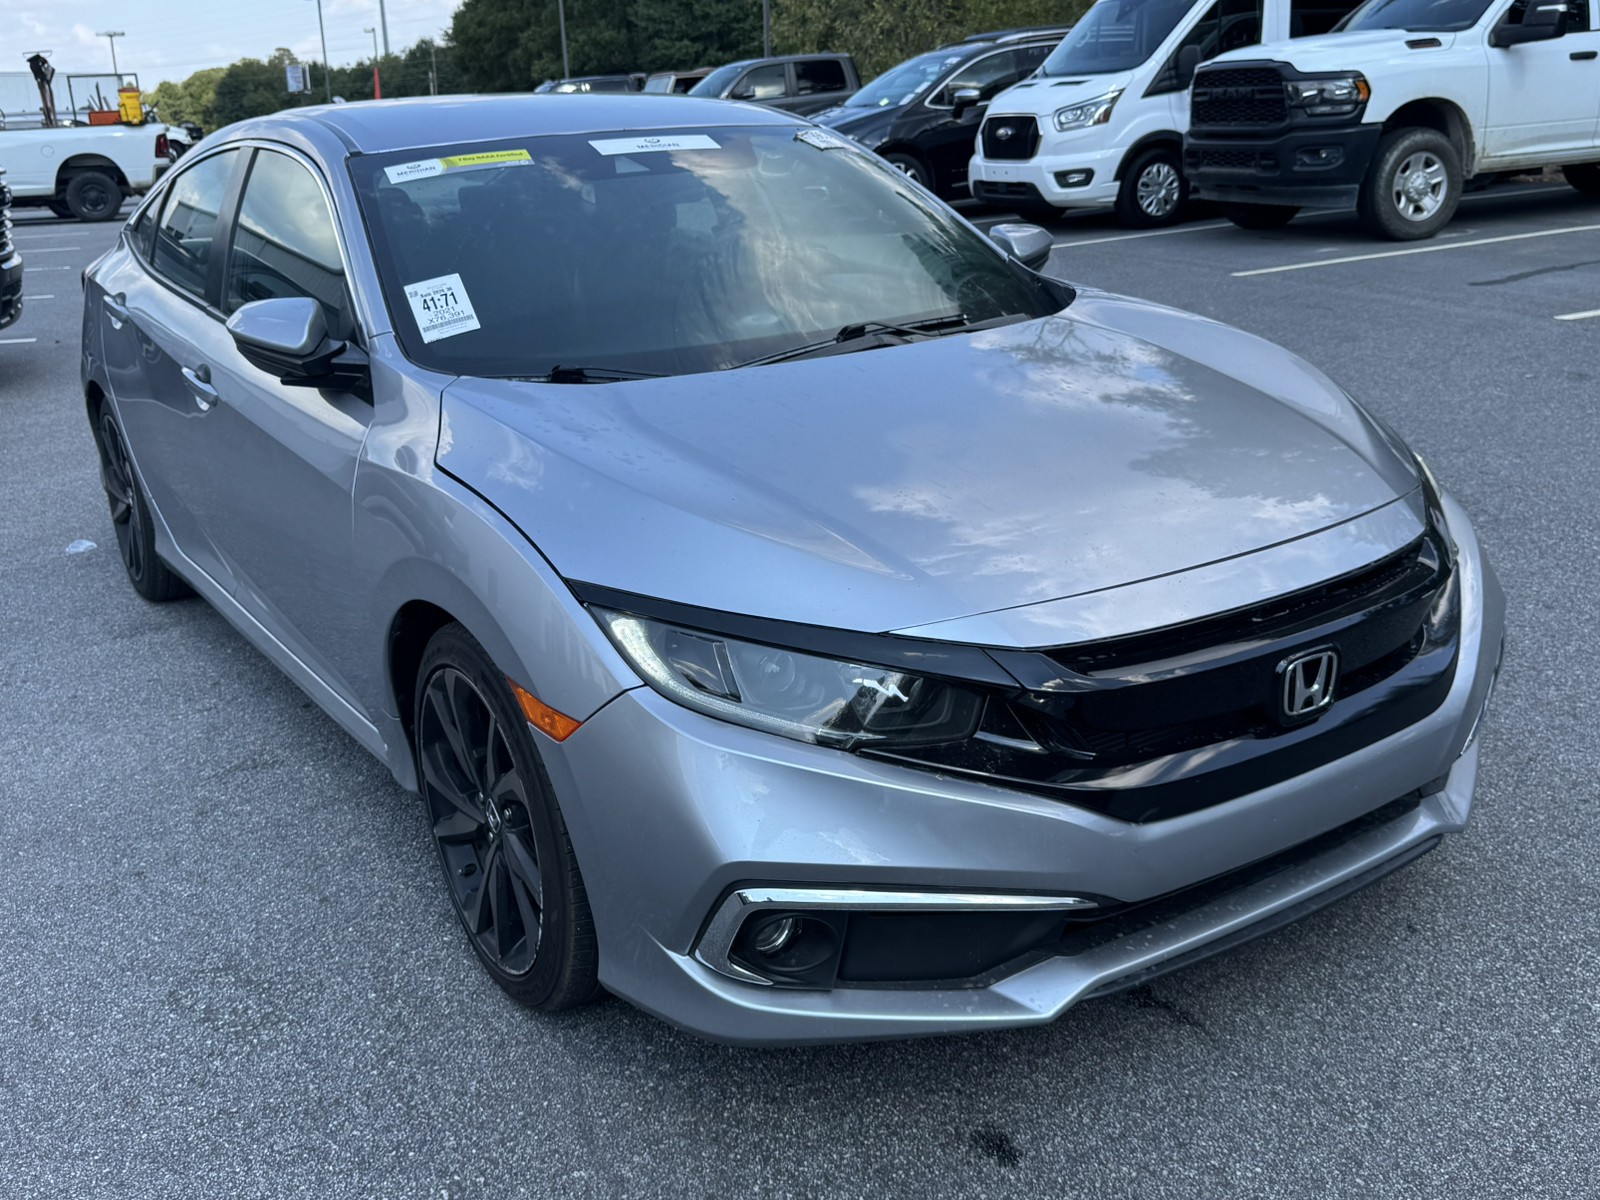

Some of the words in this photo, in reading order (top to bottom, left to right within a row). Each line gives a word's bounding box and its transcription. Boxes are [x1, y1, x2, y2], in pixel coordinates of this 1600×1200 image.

[1212, 88, 1252, 100] RAM
[396, 166, 436, 176] MERIDIAN
[422, 291, 458, 312] 41:71
[433, 306, 455, 317] 2021
